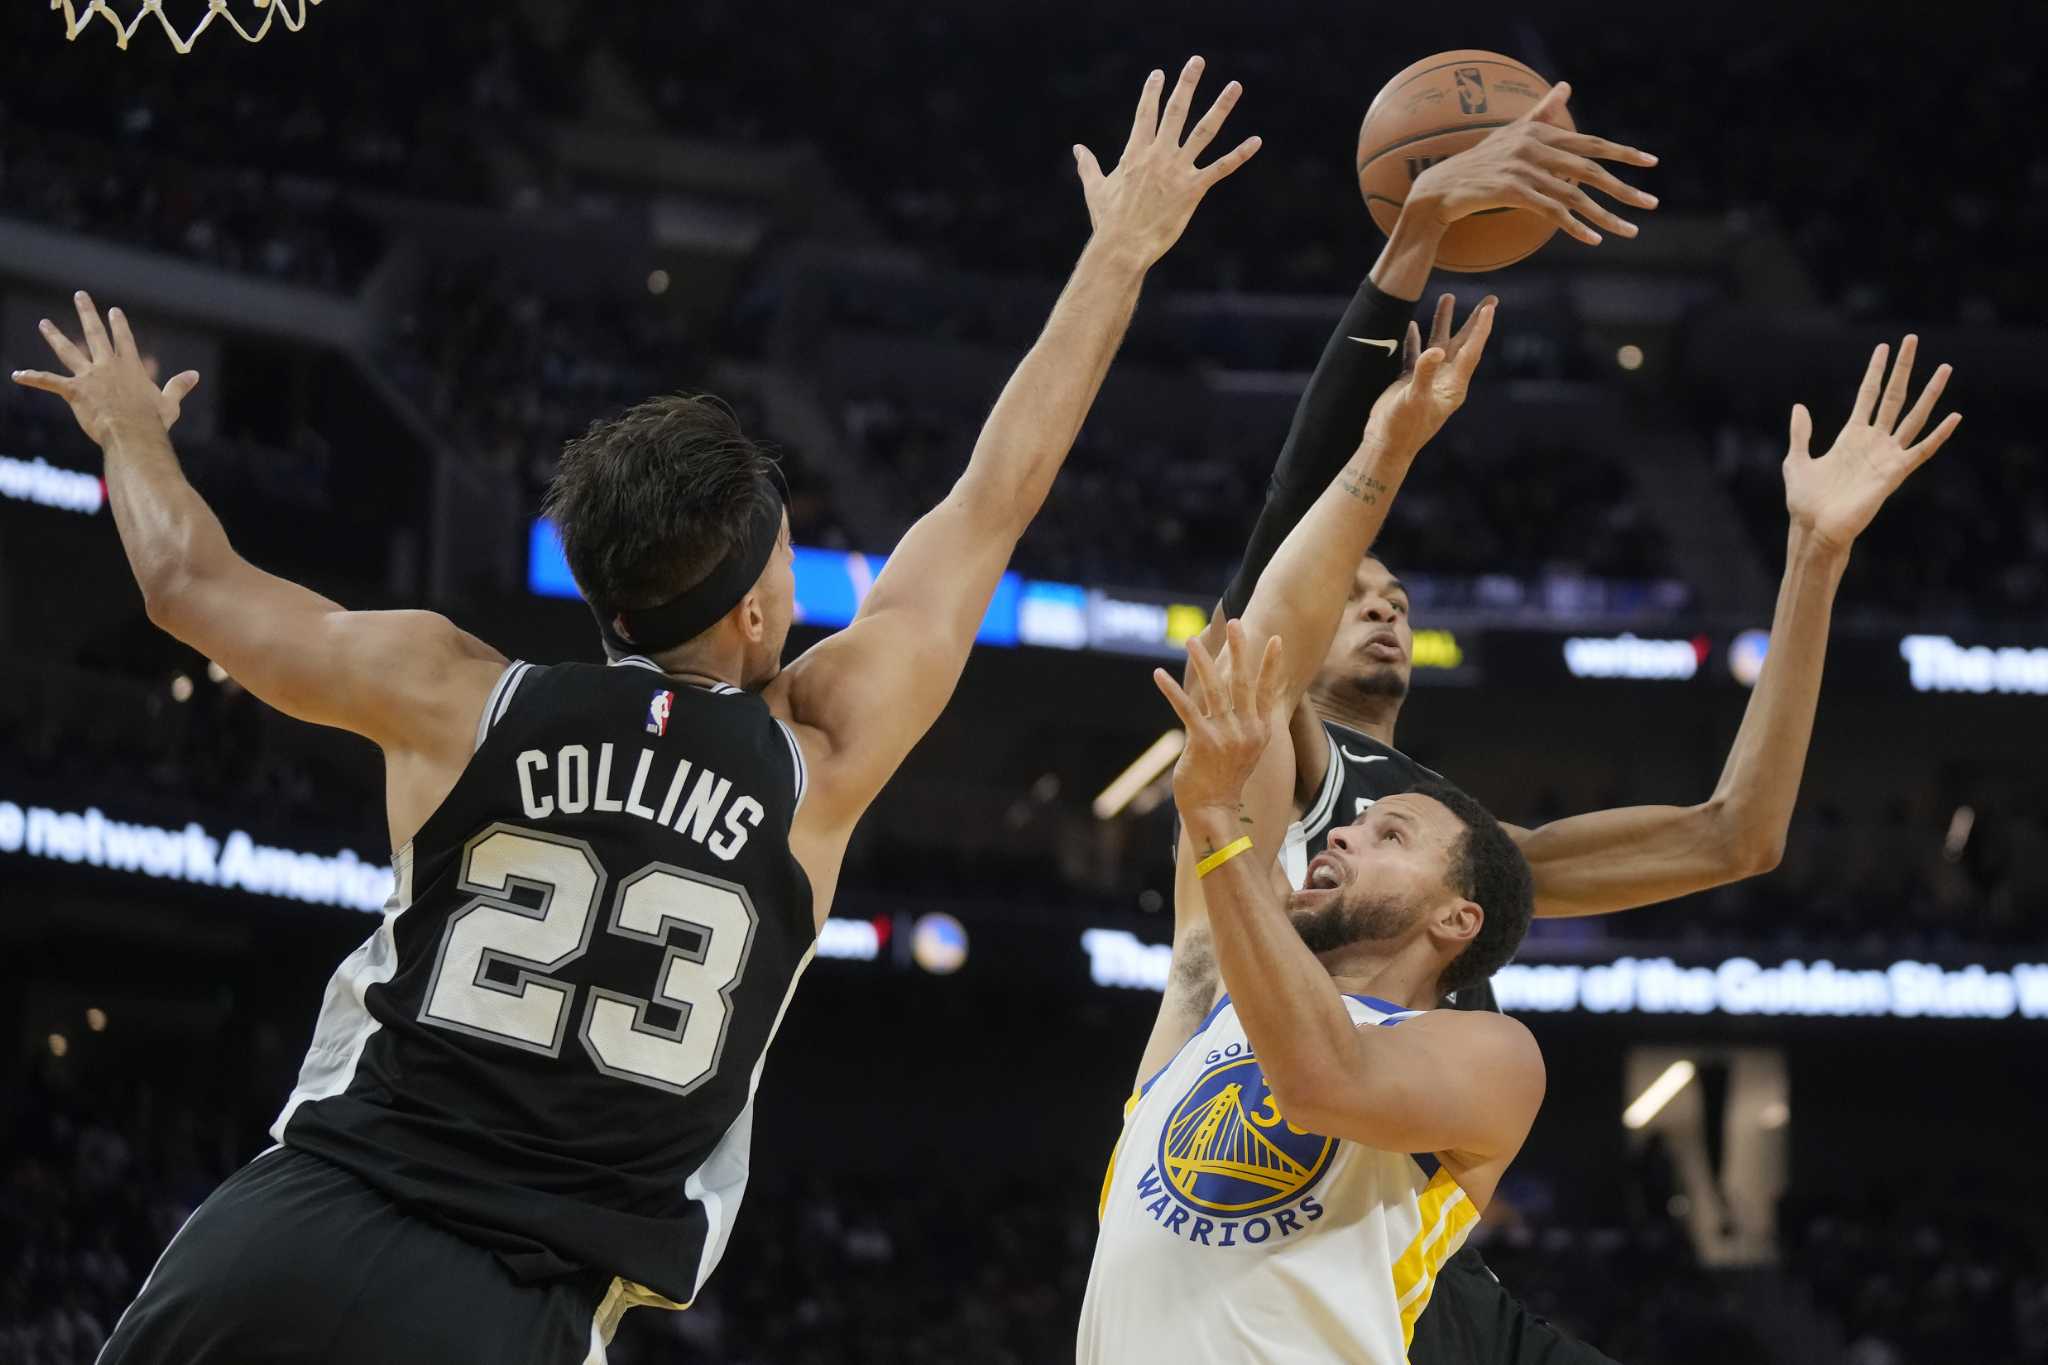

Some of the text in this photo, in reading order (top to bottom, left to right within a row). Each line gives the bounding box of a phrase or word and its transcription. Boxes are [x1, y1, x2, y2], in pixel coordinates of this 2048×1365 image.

[516, 742, 765, 861] COLLINS
[416, 822, 760, 1096] 23
[1136, 1164, 1324, 1246] WARRIORS
